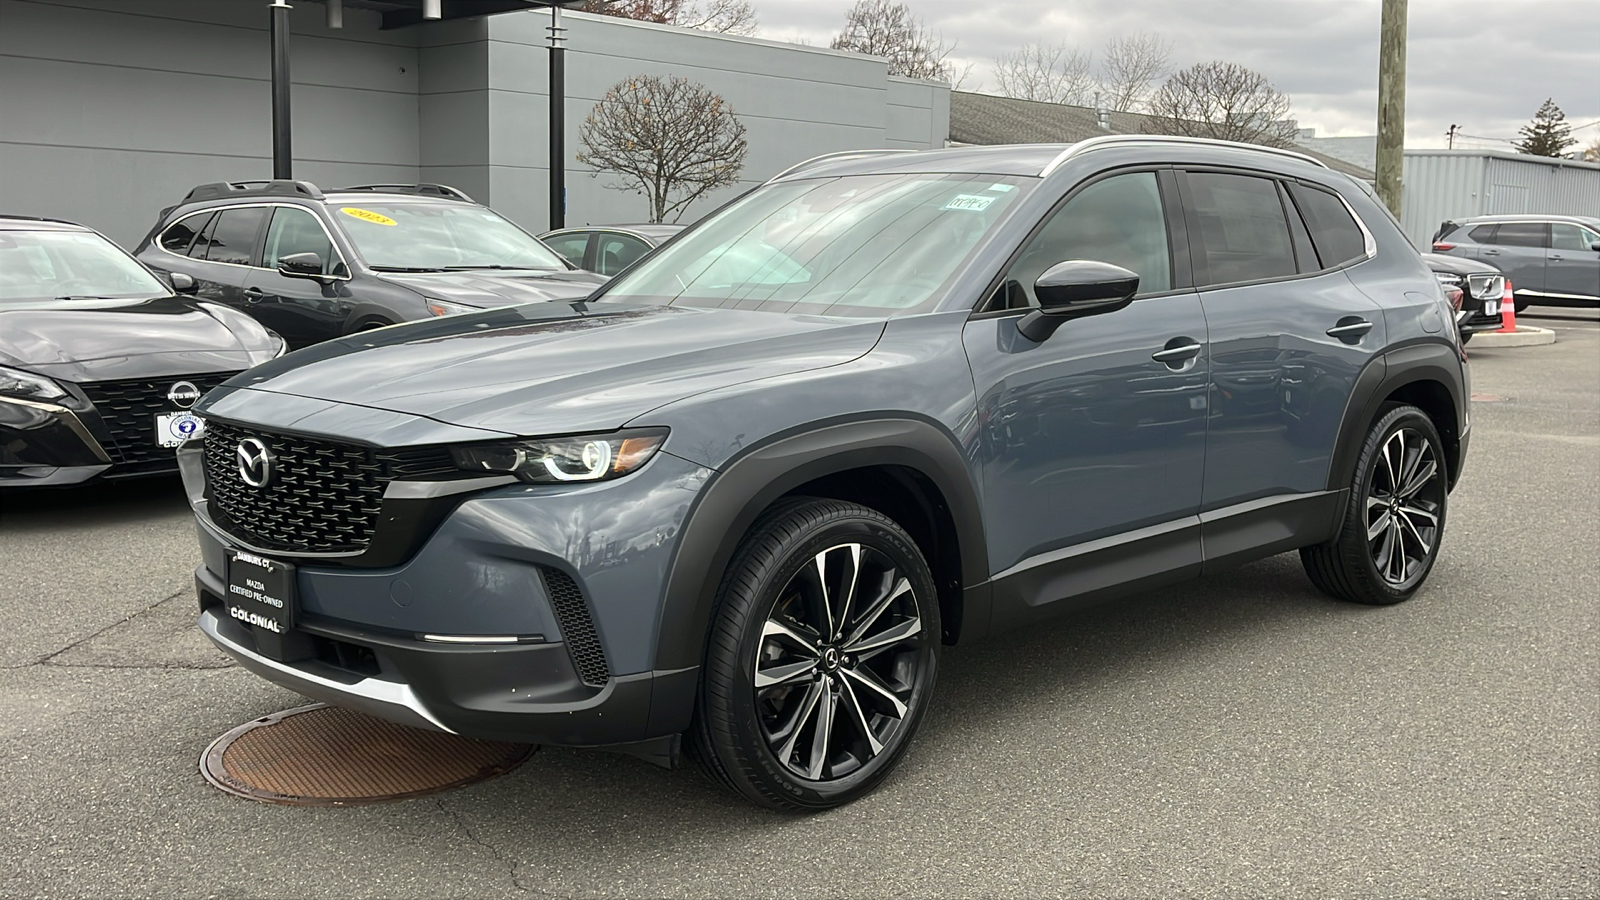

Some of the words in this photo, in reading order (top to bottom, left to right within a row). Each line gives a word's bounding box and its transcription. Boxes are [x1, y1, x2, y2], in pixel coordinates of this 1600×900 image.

[167, 391, 201, 400] NISSAN
[246, 578, 265, 591] MAZDA
[229, 584, 253, 598] CERTIFIED
[253, 591, 283, 609] PRE-OWNED
[230, 606, 280, 633] COLONIAL
